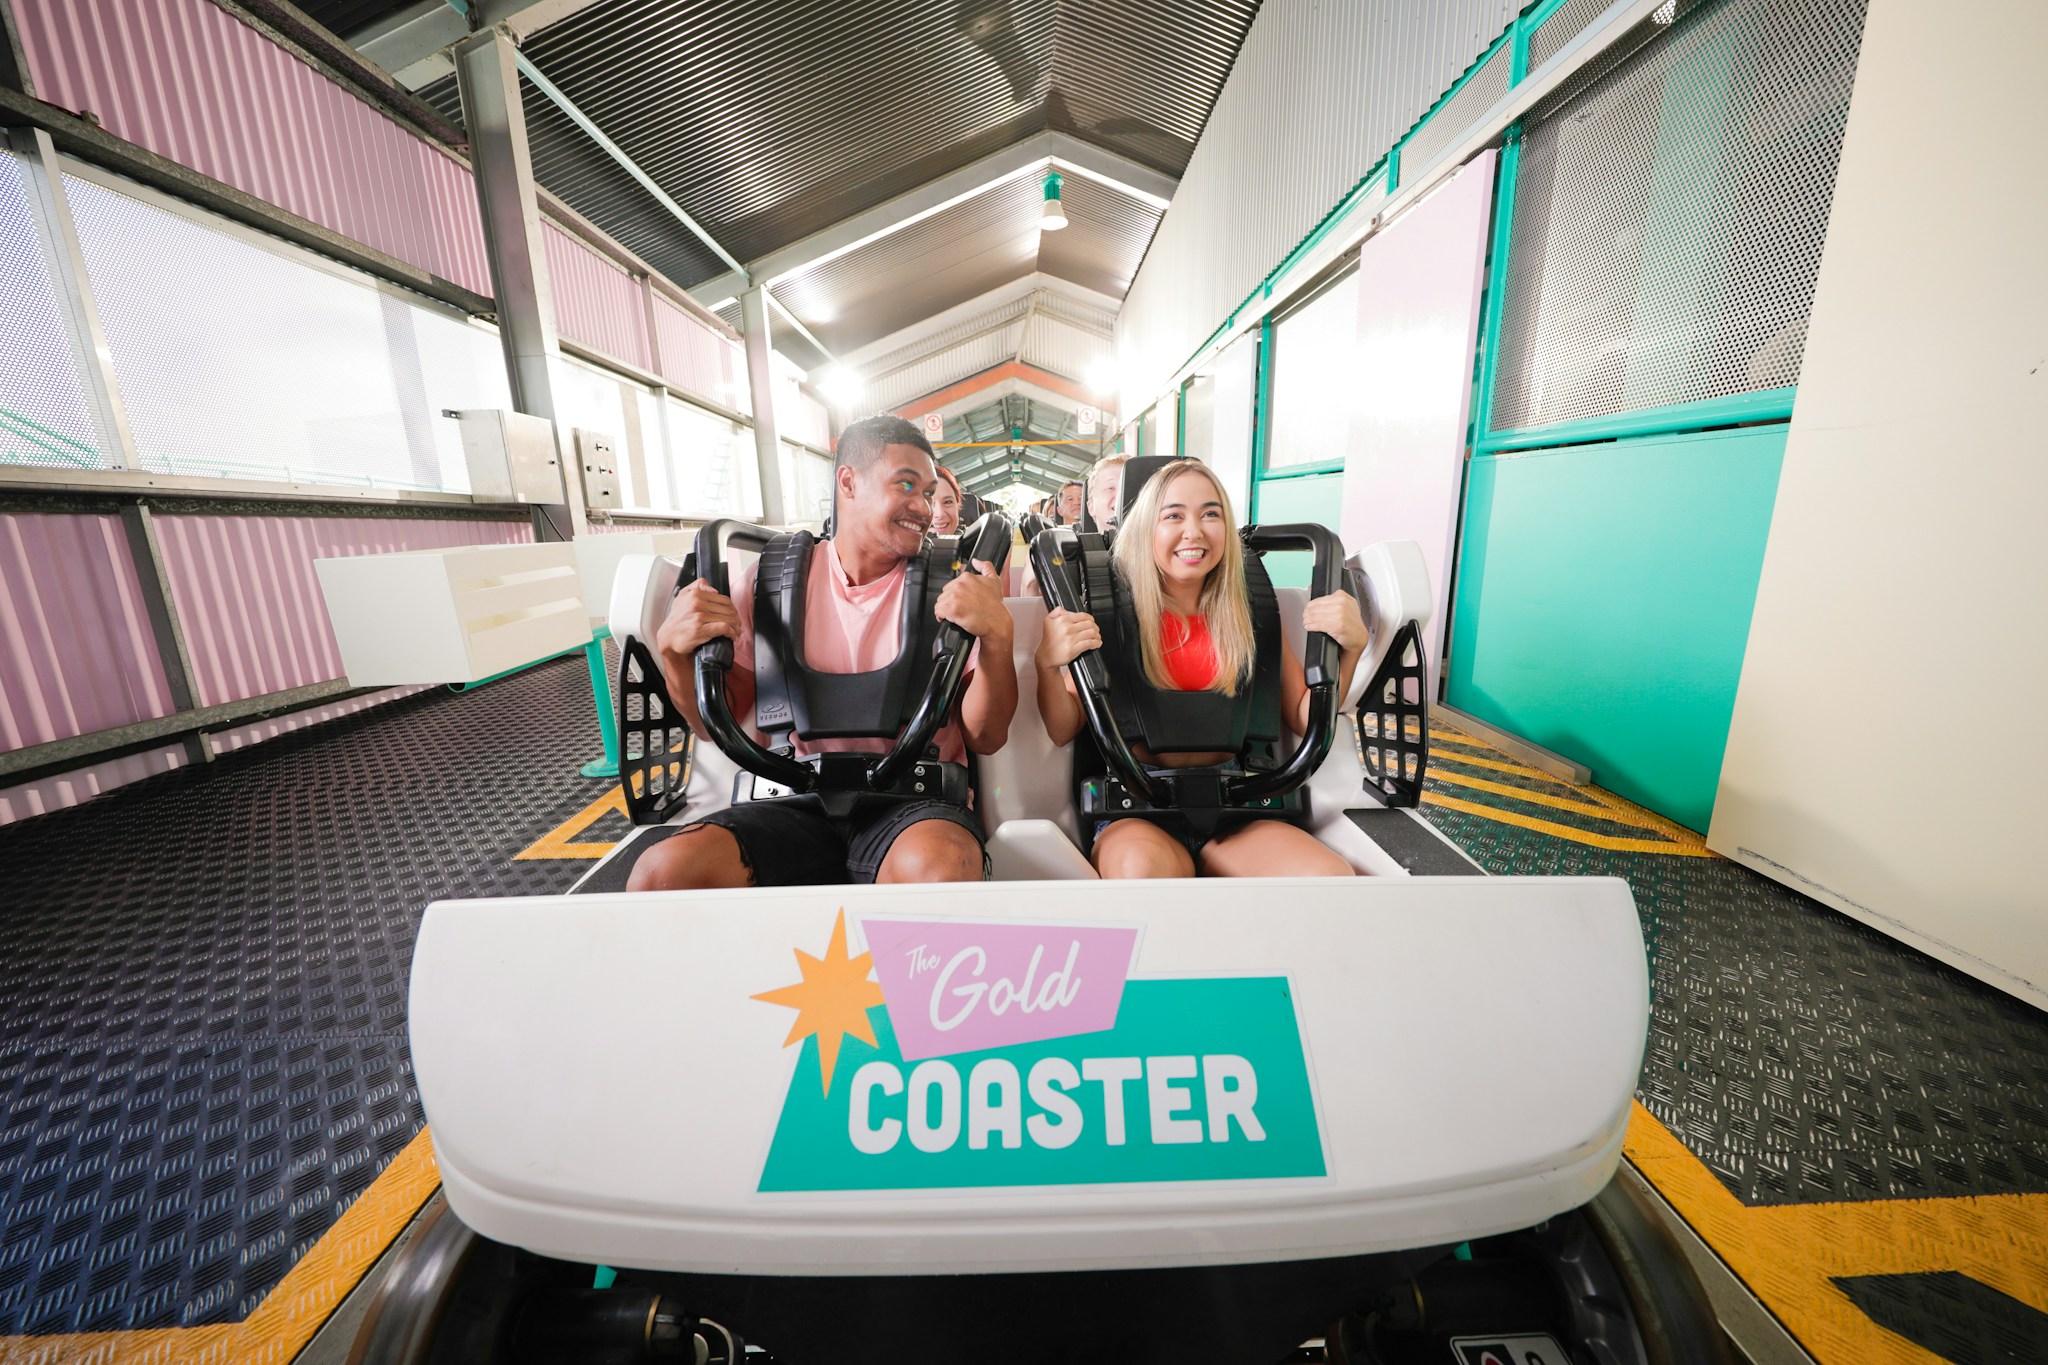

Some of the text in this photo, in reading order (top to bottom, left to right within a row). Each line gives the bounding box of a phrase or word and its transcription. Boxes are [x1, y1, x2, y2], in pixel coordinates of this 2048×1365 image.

[906, 941, 1081, 1031] The Gold
[848, 1055, 1267, 1155] COASTER
